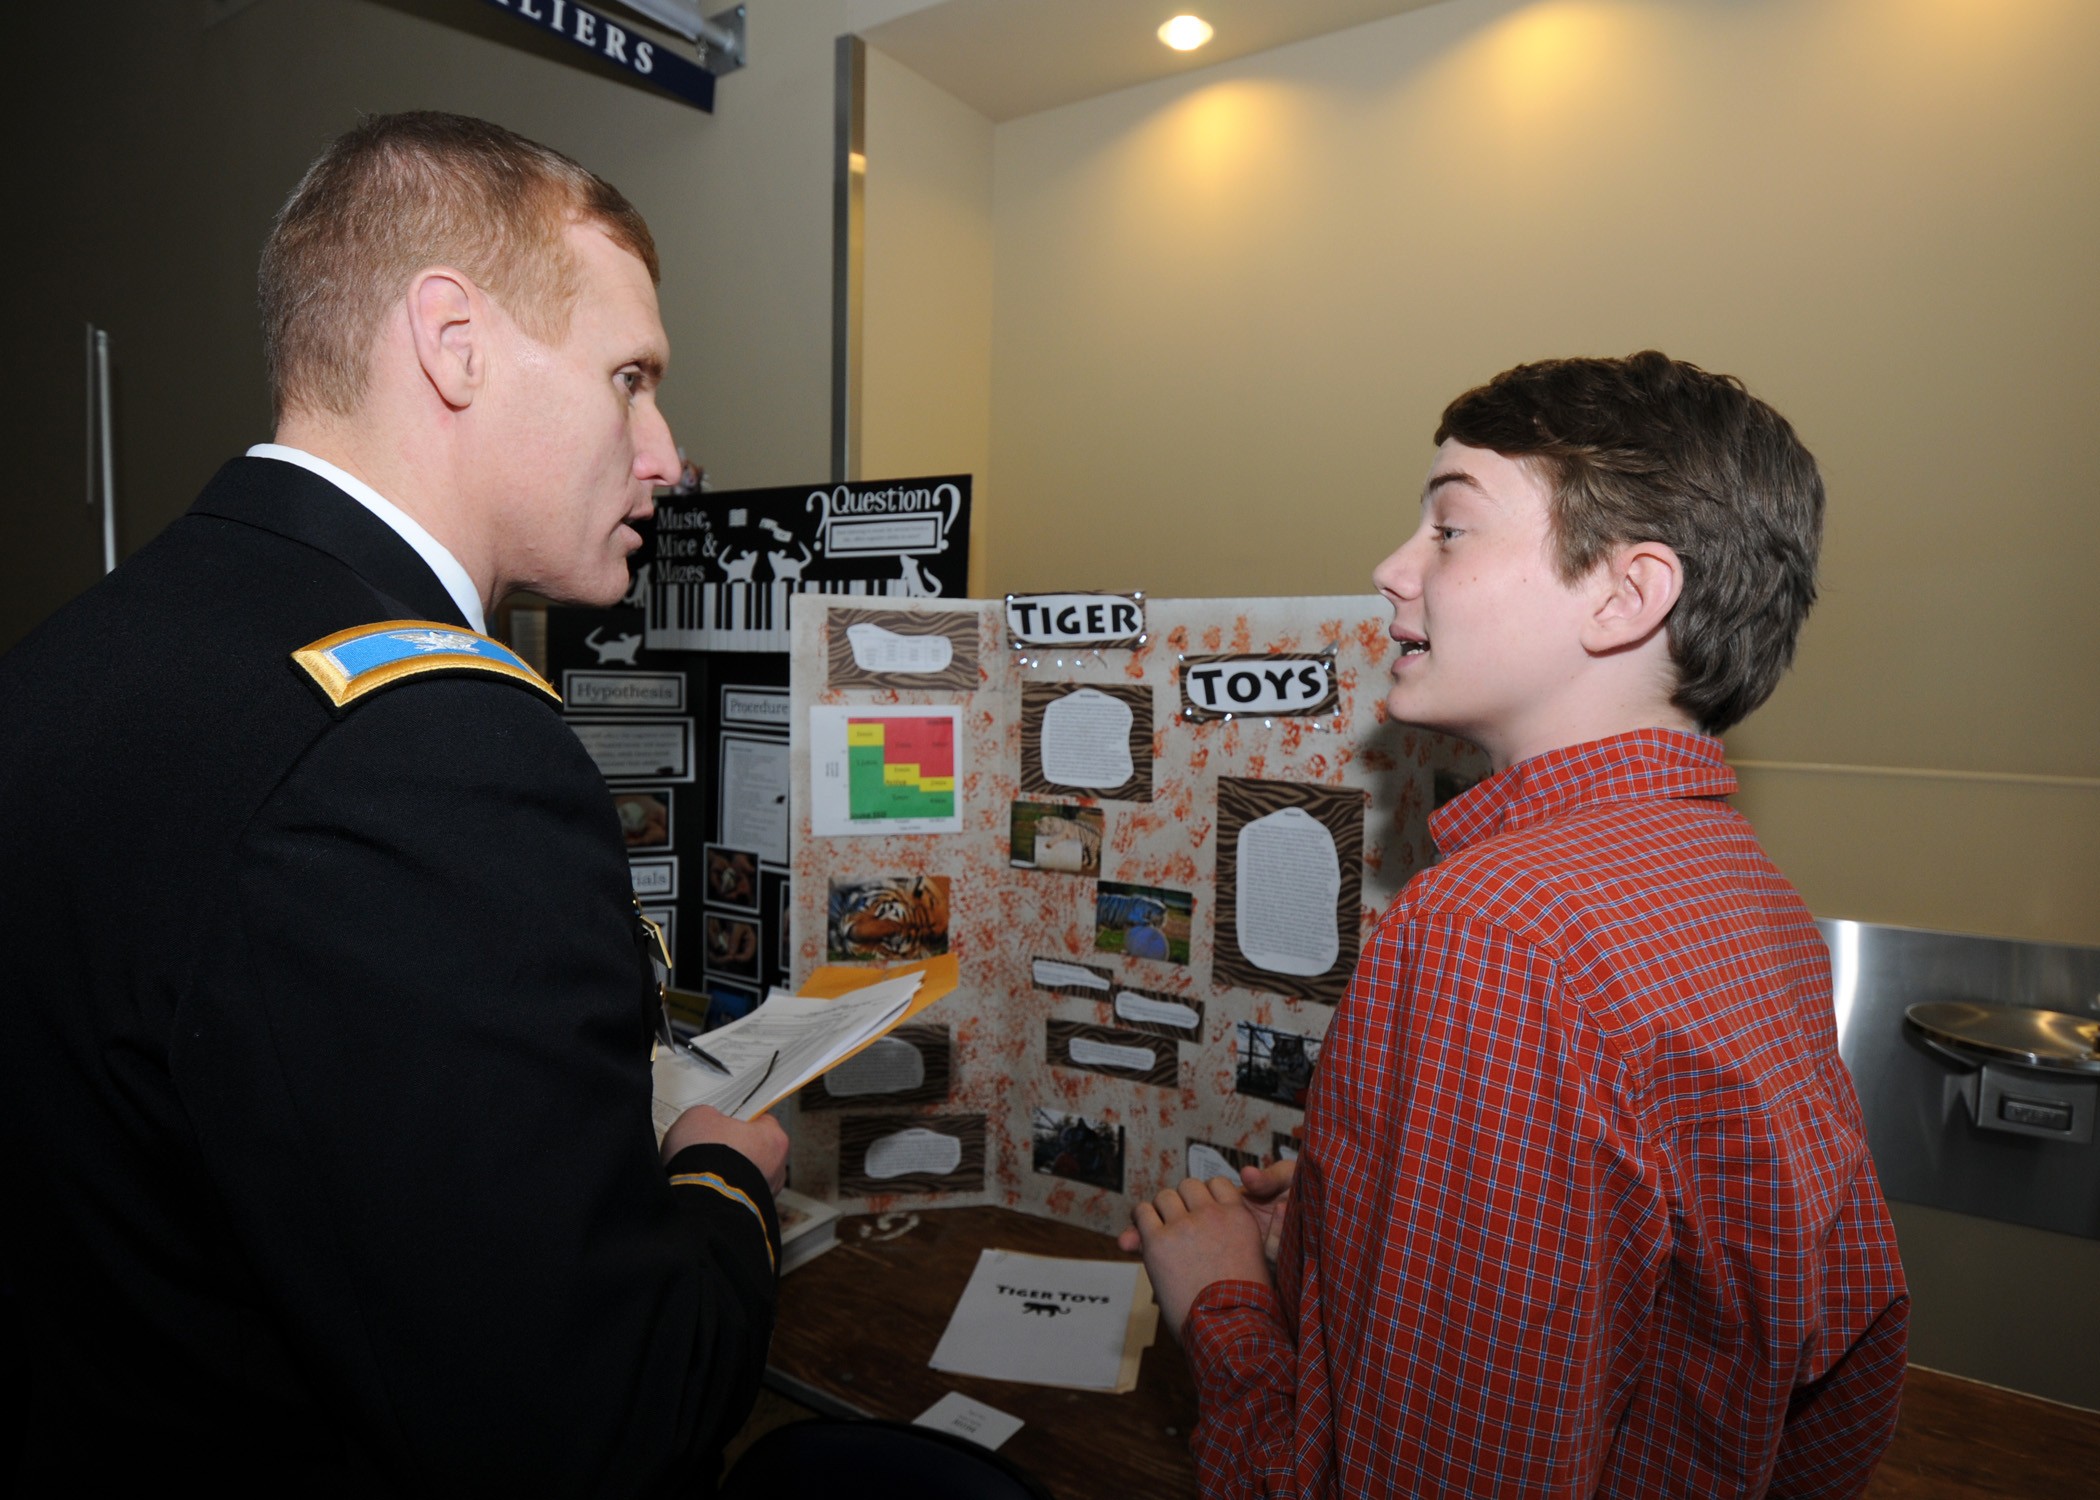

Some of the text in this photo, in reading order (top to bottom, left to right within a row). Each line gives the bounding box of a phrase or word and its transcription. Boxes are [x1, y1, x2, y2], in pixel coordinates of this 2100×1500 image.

[496, 0, 654, 74] LIERS
[656, 507, 712, 531] Music,
[656, 534, 718, 558] Mice &
[656, 559, 705, 583] Mazes
[1011, 602, 1139, 635] TIGER
[577, 682, 674, 701] Hypothesis
[1192, 666, 1322, 706] TOYS
[729, 699, 789, 714] Procedure
[997, 1284, 1110, 1305] TIGER TOYS
